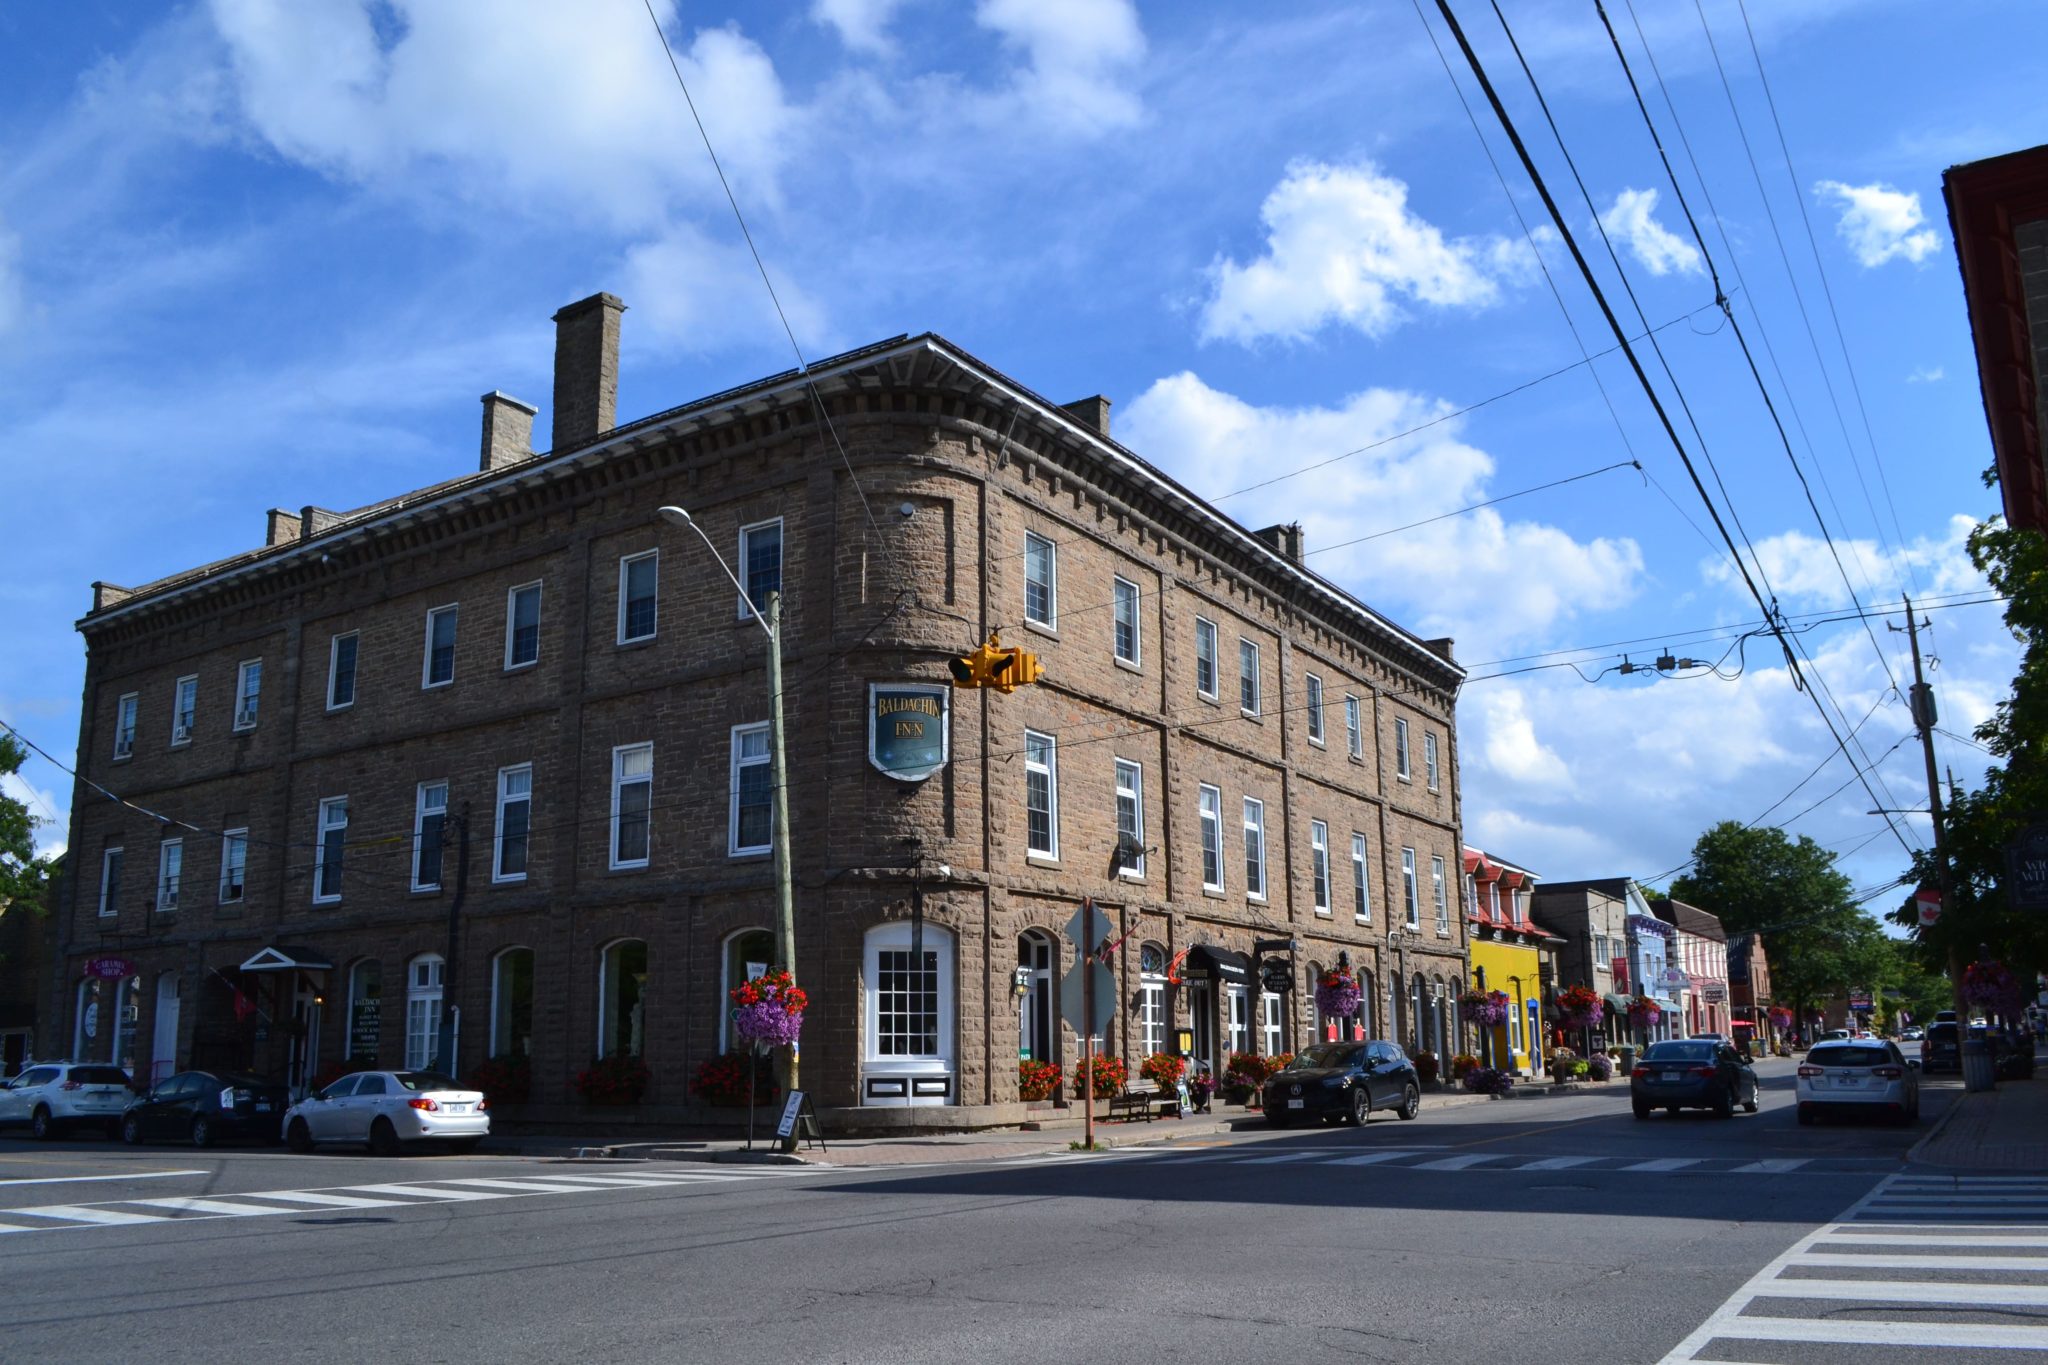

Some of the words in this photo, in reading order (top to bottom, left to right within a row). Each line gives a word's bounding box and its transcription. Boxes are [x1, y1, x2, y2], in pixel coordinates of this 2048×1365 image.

[878, 698, 940, 720] BALDACHIN
[95, 960, 125, 970] CARAMEL
[102, 968, 121, 977] SHOP
